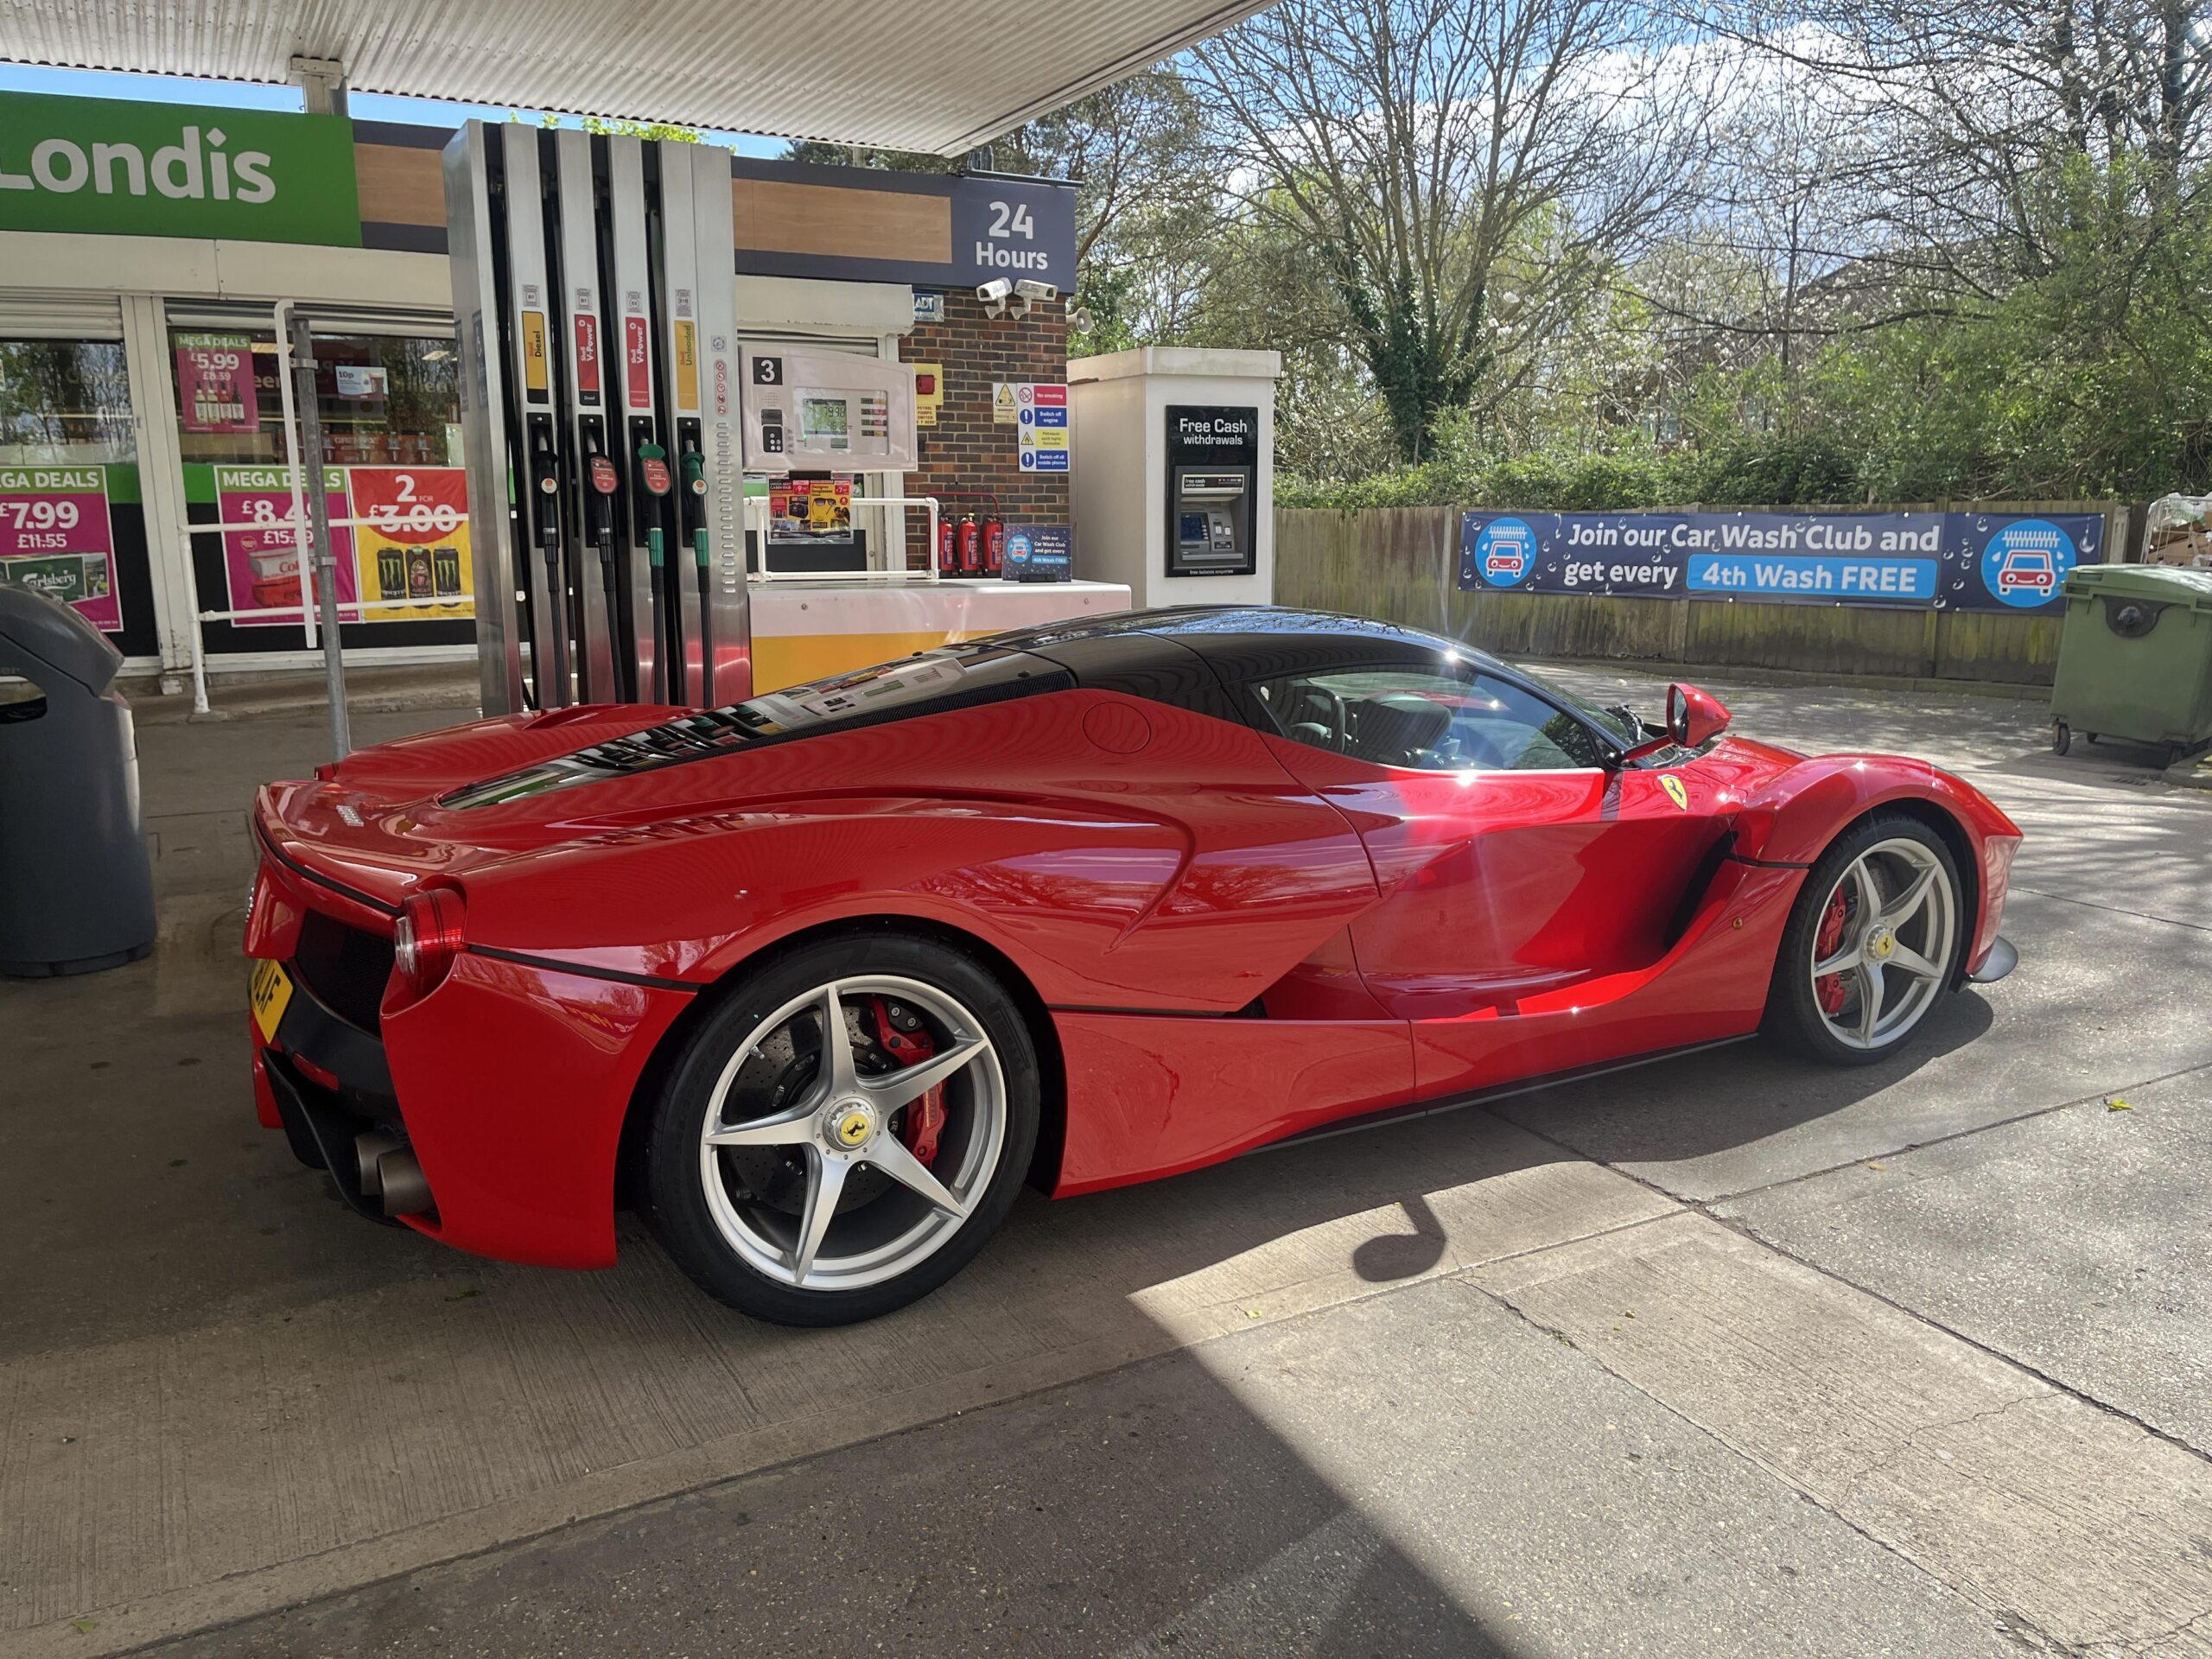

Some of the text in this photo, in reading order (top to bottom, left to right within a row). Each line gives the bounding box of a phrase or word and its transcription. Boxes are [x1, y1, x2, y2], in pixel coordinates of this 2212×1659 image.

[988, 201, 1033, 239] 24
[976, 241, 1048, 270] Hours
[916, 296, 934, 310] ADT
[179, 336, 248, 347] MEGA DEALS
[532, 330, 542, 357] Diesel
[683, 324, 692, 366] Unleaded
[190, 353, 240, 370] £5.99
[760, 359, 776, 382] 3
[339, 371, 354, 379] 10p
[1179, 418, 1247, 433] Free Cash
[1184, 435, 1243, 445] withdrawals
[0, 472, 99, 488] GA DEALS
[223, 472, 341, 487] MEGA DES
[395, 474, 416, 502] 2
[0, 500, 79, 530] £7.99
[242, 499, 312, 524] £8.4
[369, 504, 457, 533] £3.00
[17, 533, 68, 549] £11.55
[263, 530, 315, 544] £15.9
[1567, 522, 1940, 551] Join our Car Wash Club and
[22, 571, 77, 589] Carlsberg
[1563, 563, 1916, 593] get every 4th Wash FREE
